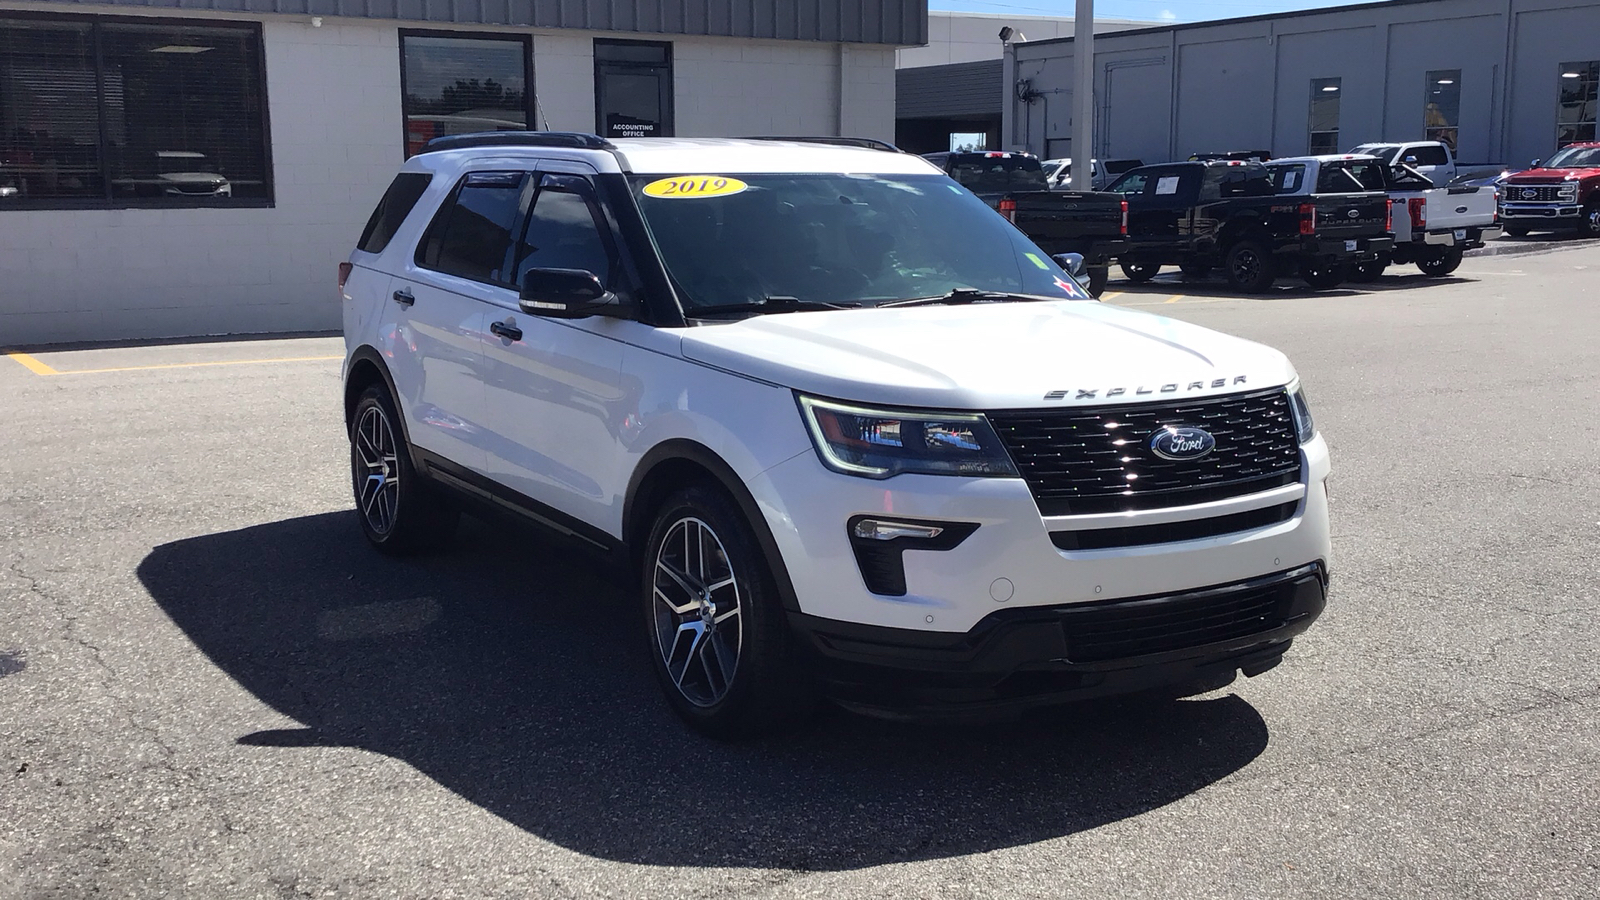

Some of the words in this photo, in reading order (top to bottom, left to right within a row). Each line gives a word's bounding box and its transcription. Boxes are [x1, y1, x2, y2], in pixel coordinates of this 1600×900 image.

[662, 179, 728, 195] 2019
[1043, 375, 1248, 400] EXPLORER
[1170, 432, 1205, 453] Ford
